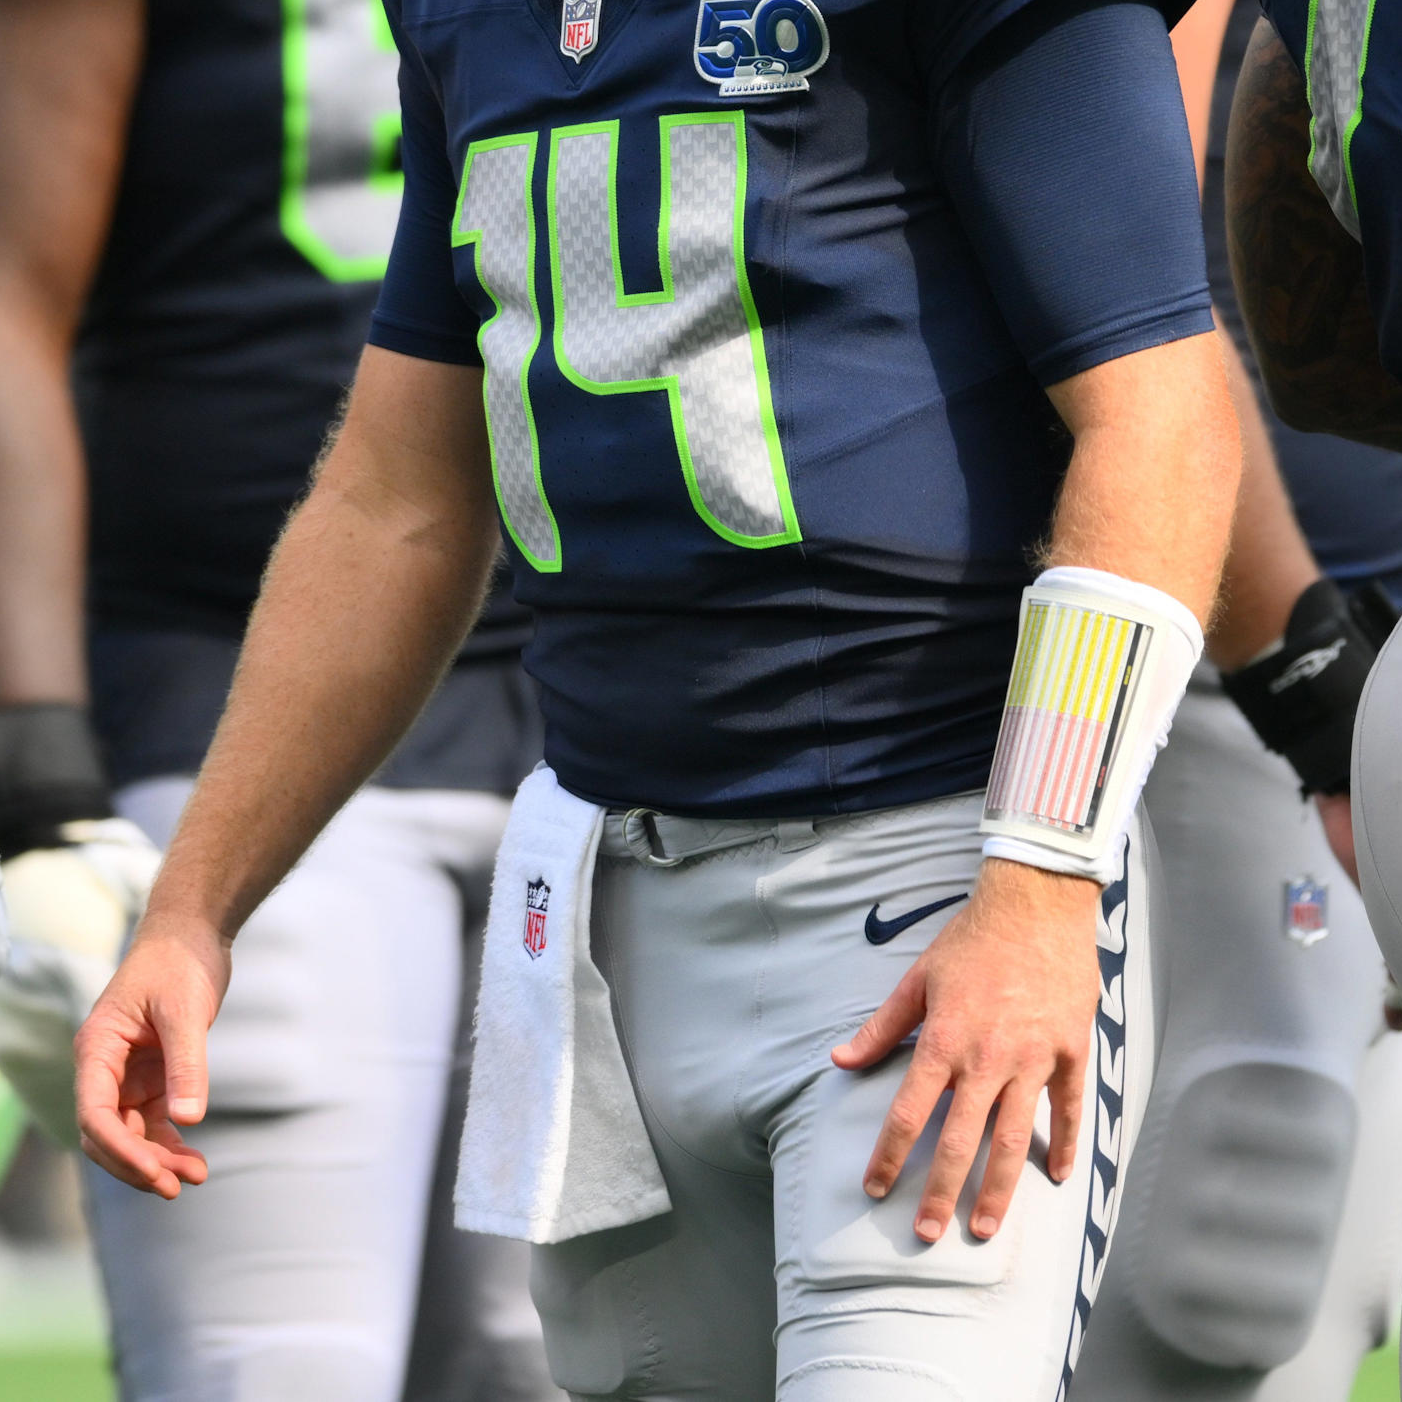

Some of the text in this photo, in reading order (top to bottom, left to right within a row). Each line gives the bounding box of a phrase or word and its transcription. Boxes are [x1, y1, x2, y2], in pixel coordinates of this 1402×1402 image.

[565, 22, 592, 50] NFL
[451, 109, 803, 573] 14
[525, 911, 547, 953] NFL
